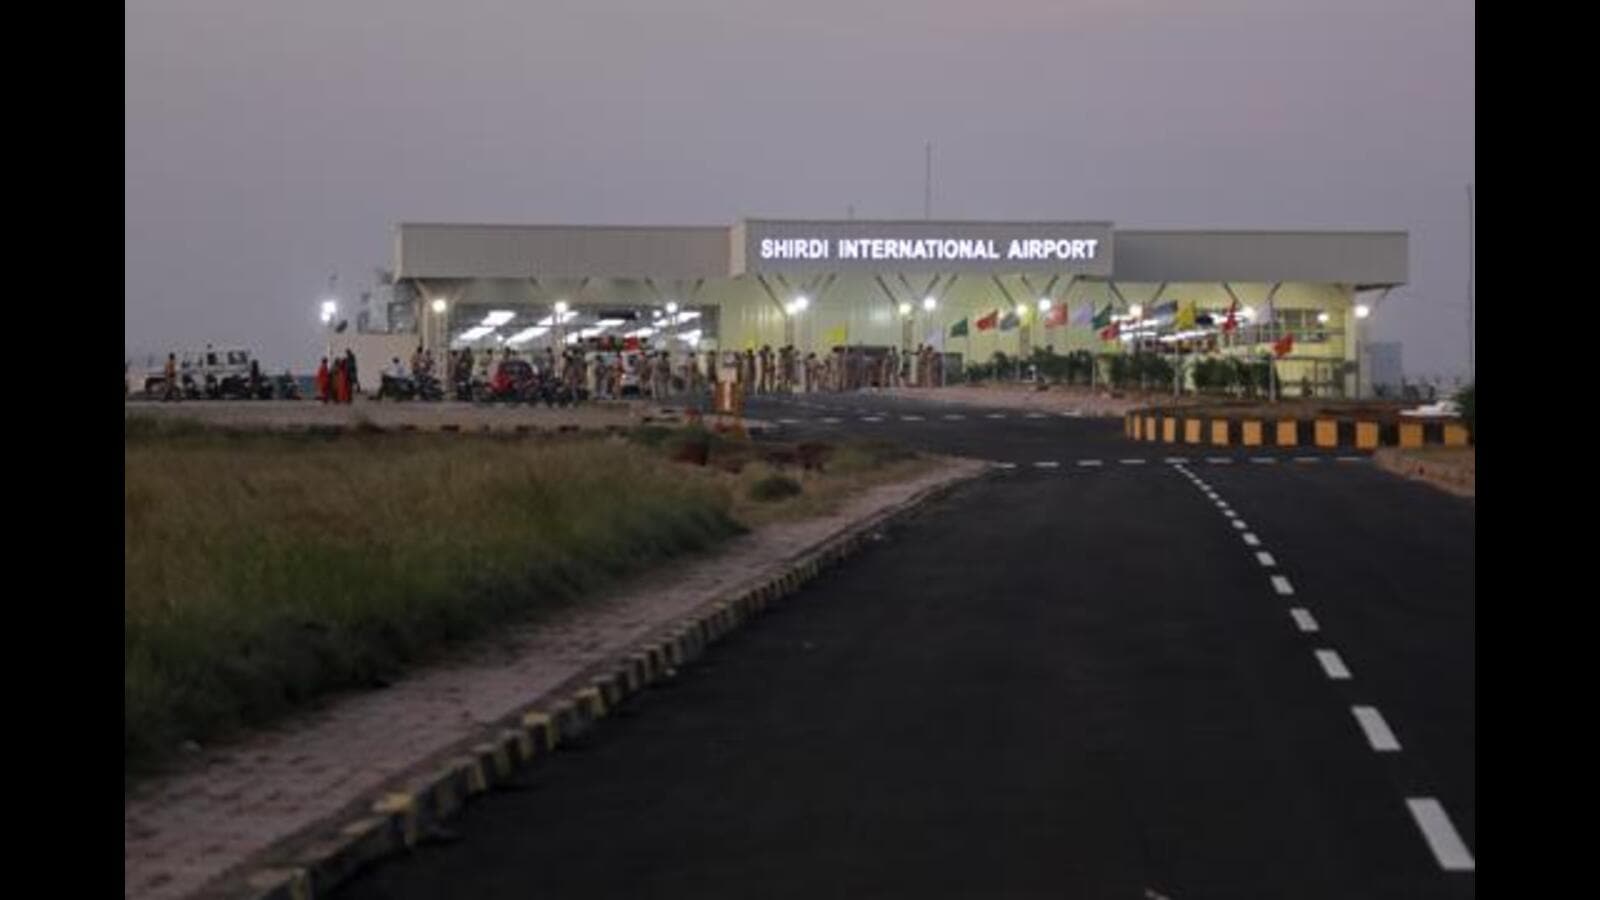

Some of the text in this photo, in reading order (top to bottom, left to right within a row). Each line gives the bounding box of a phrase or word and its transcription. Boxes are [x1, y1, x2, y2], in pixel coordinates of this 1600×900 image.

[760, 239, 1098, 259] SHIRDI INTERNATIONAL AIRPORT
